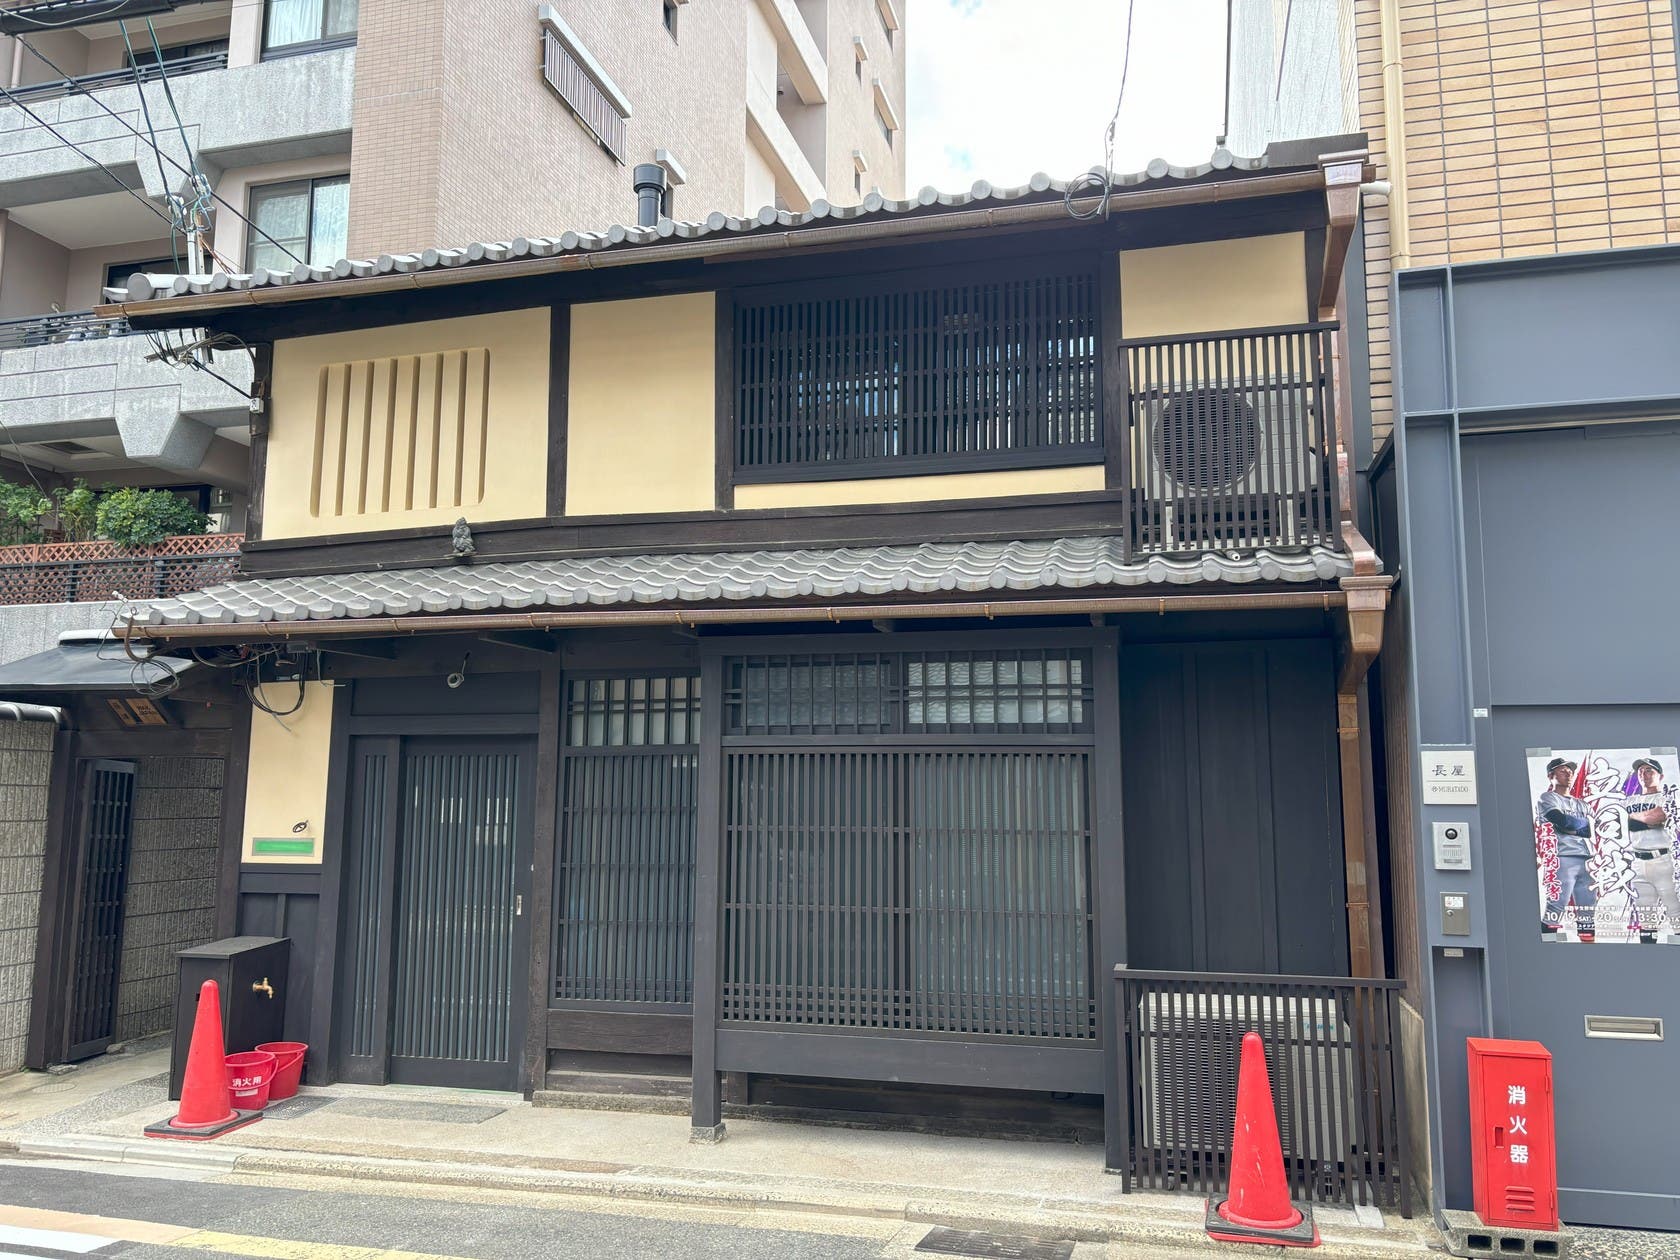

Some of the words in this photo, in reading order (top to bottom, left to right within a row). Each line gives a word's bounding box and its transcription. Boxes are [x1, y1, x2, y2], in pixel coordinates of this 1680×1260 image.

[1431, 764, 1465, 777] 長屋
[1583, 756, 1639, 898] 立同戦
[232, 1075, 262, 1087] 消火用
[1507, 1084, 1529, 1164] 消火器
